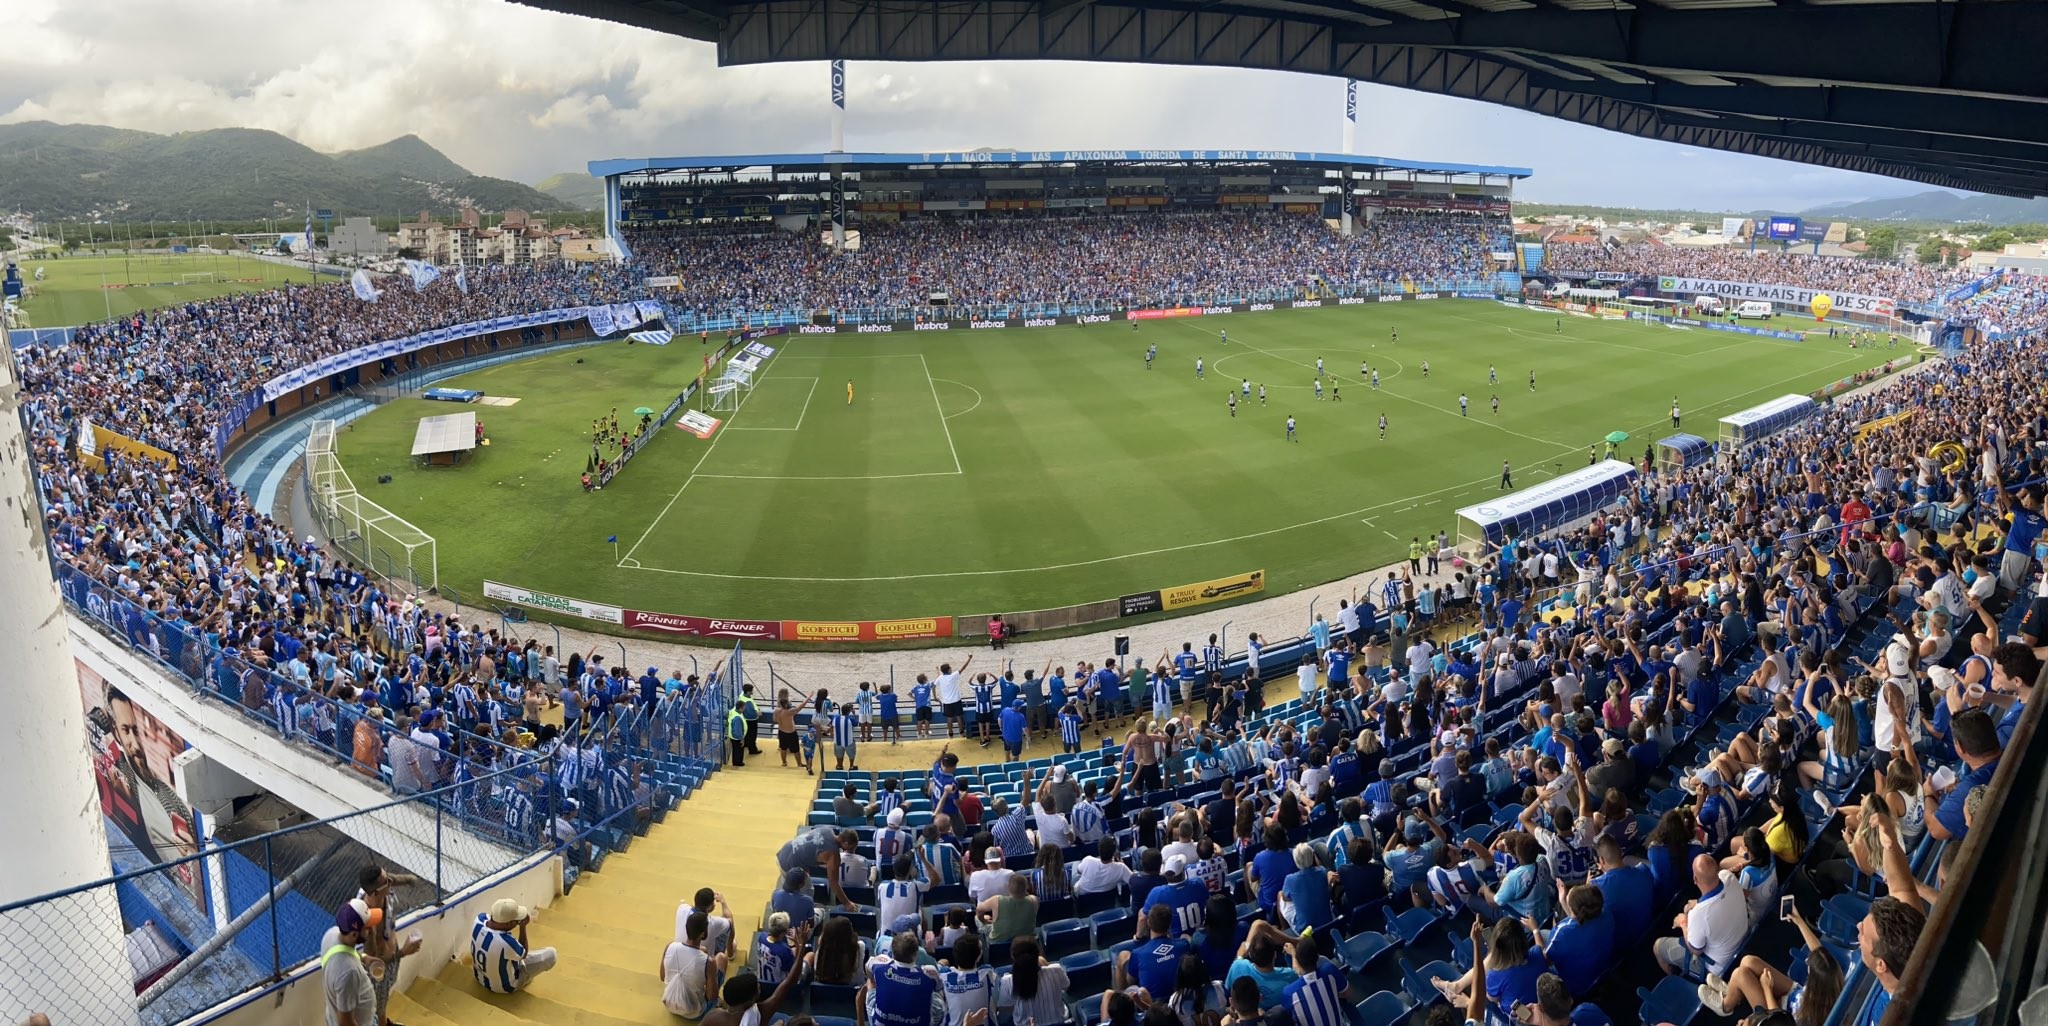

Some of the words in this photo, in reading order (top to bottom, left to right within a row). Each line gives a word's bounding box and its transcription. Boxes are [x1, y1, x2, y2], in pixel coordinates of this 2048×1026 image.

[1139, 151, 1182, 160] TORCIDA
[1193, 151, 1206, 159] DE
[1218, 151, 1248, 159] SANTA
[1678, 280, 1689, 290] A
[1694, 281, 1742, 295] MAIOR
[1745, 286, 1755, 297] E
[1757, 287, 1795, 300] MAIS
[1835, 295, 1854, 308] DE
[1856, 299, 1877, 311] SC
[970, 319, 1006, 329] intelbras
[1077, 314, 1110, 324] itelbras
[800, 324, 836, 334] intelbras
[858, 324, 893, 333] intelbras
[1176, 589, 1195, 598] TRULY
[517, 595, 583, 613] CATARINENSE
[529, 592, 570, 606] TENDAS
[1170, 595, 1197, 605] RESOLVE
[636, 612, 688, 627] RENNER
[709, 620, 765, 632] RENNER
[801, 626, 855, 634] KOERICH
[880, 623, 932, 632] KOERICH
[508, 690, 517, 698] 10
[1196, 863, 1222, 877] CAIXA
[1176, 902, 1201, 931] 10
[1156, 953, 1175, 964] umbro
